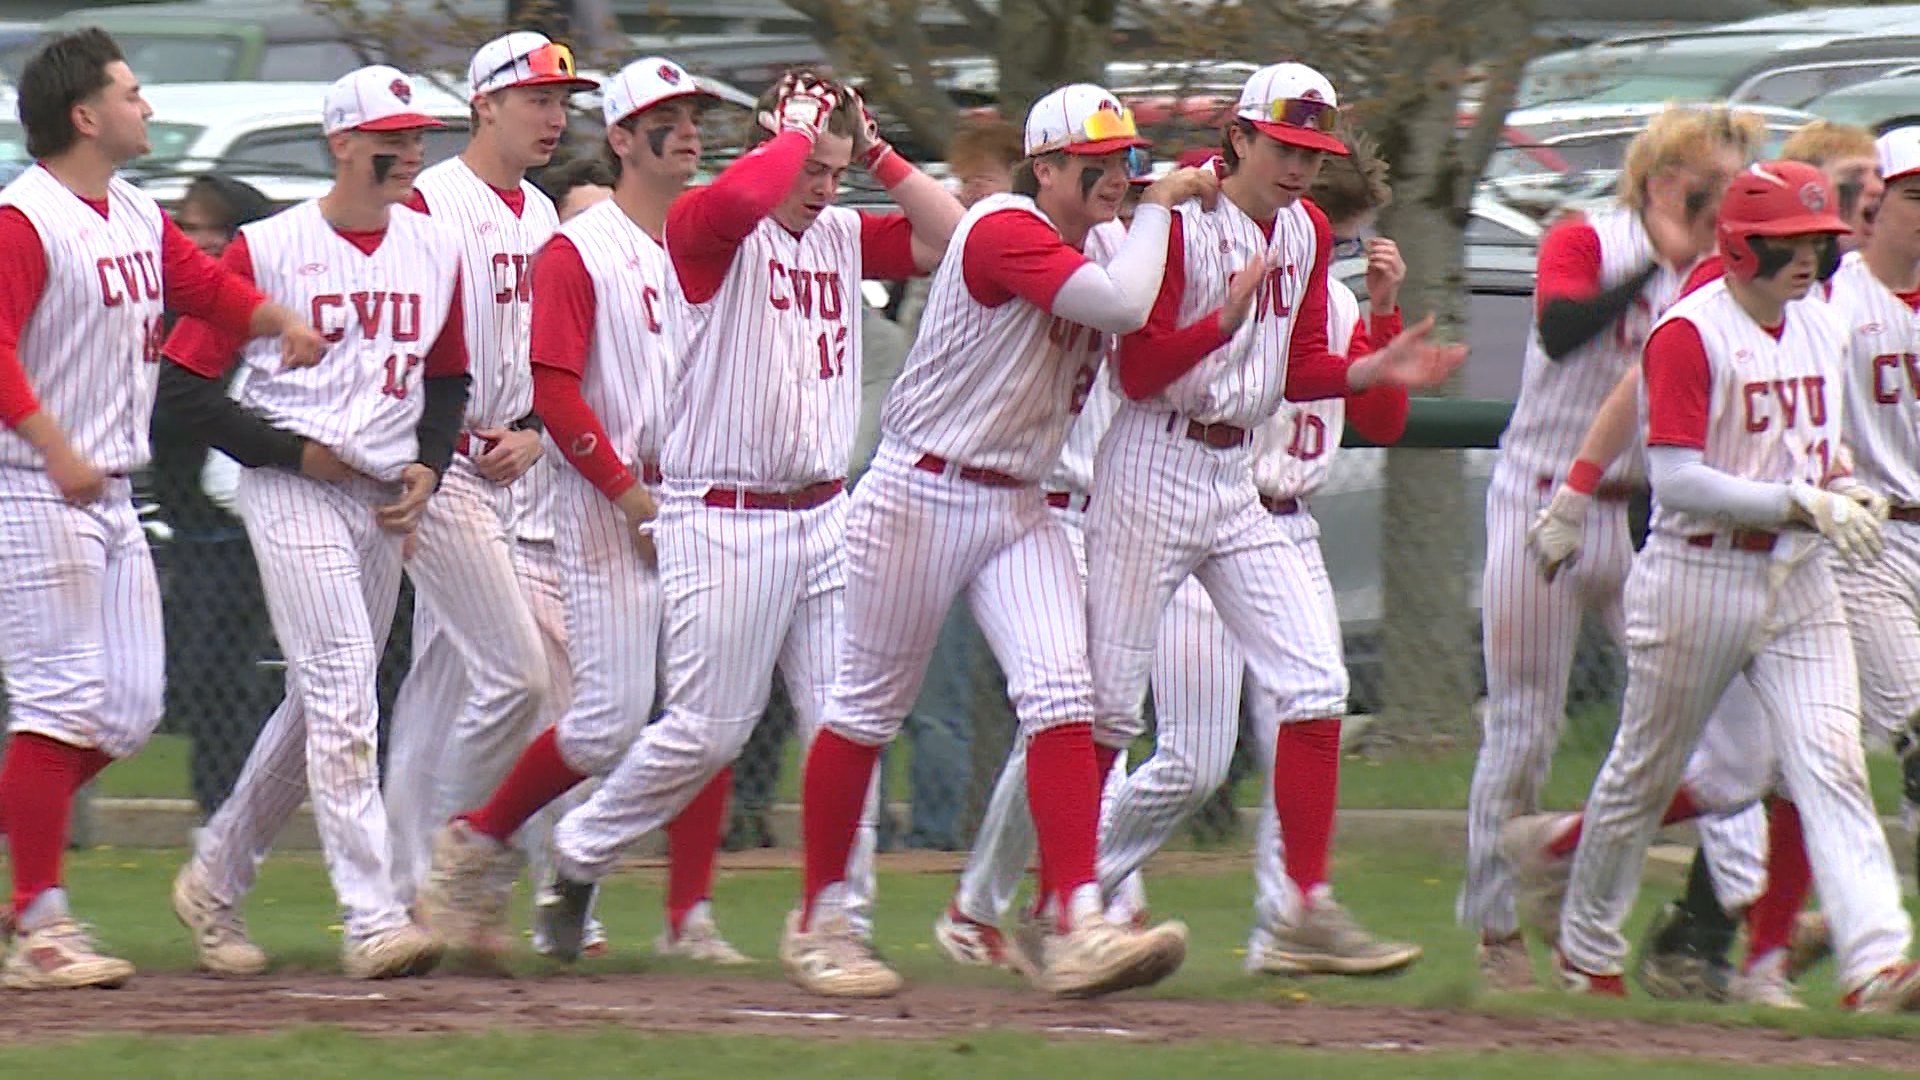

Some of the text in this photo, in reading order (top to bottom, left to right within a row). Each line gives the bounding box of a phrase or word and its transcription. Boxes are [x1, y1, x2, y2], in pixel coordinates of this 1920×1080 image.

[97, 250, 160, 306] CVU
[768, 259, 841, 319] CVU
[312, 291, 421, 342] CVU
[1744, 376, 1827, 432] CVU
[1287, 409, 1326, 461] 10
